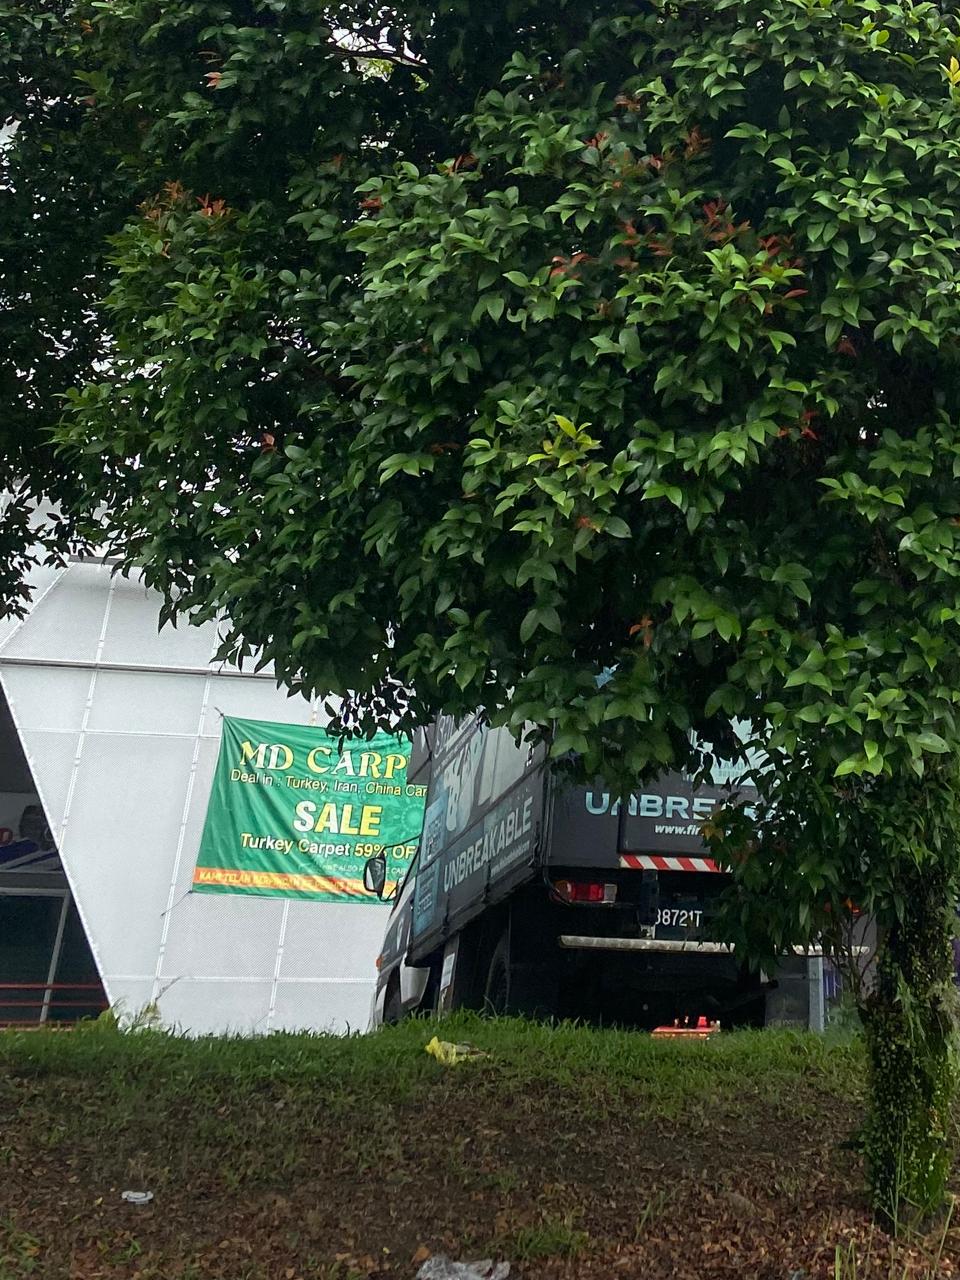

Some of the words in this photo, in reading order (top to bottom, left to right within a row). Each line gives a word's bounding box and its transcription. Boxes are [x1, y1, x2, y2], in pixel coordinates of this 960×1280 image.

[240, 741, 294, 770] MD
[307, 747, 409, 780] CARP
[231, 769, 260, 784] Deal
[262, 773, 273, 786] in
[286, 775, 329, 793] Turkey,
[366, 781, 401, 796] China
[405, 784, 428, 797] Car
[293, 800, 383, 837] SALE
[654, 824, 701, 836] www.fir
[241, 833, 293, 854] Turkey
[298, 839, 350, 858] Carpet
[355, 843, 387, 858] 59%
[392, 844, 416, 859] OF
[444, 796, 533, 893] UNBREAKABLE
